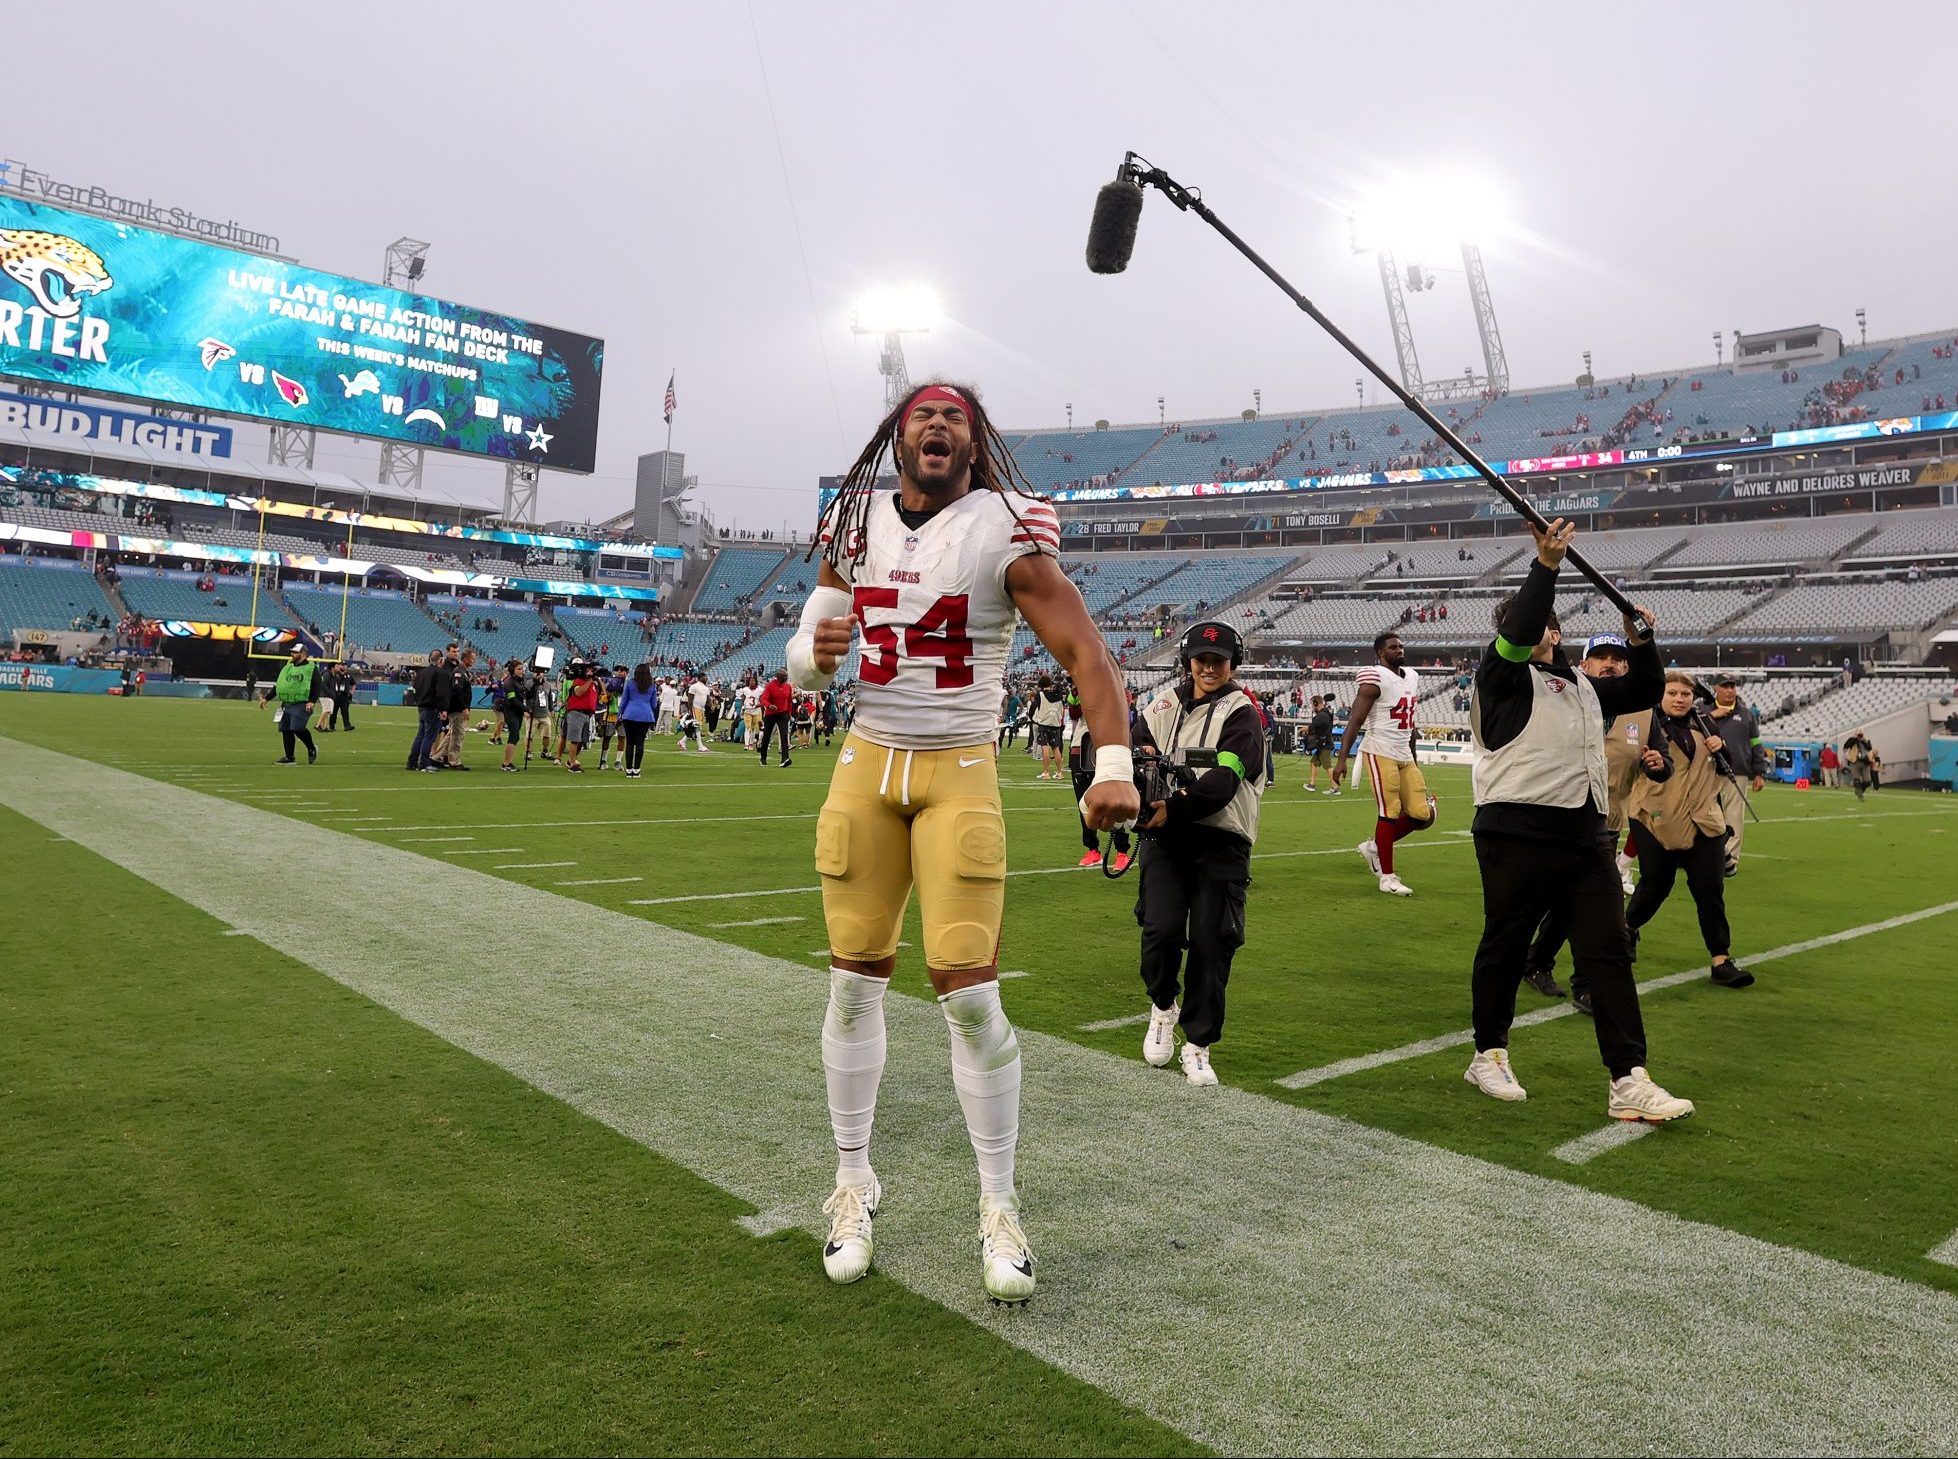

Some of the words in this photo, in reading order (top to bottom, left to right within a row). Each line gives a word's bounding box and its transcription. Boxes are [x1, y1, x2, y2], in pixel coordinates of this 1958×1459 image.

[20, 168, 161, 221] EverBank
[167, 207, 280, 252] Stadium
[228, 269, 275, 295] LIVE
[280, 281, 329, 307] LATE
[333, 294, 387, 320] GAME
[390, 307, 455, 335] ACTION
[460, 323, 508, 347] FROM
[511, 334, 543, 355] THE
[268, 298, 335, 327] FARAH
[340, 314, 354, 331] &
[360, 318, 420, 345] FARAH
[425, 332, 459, 353] FAN
[464, 341, 509, 364] DECK
[317, 337, 351, 356] THIS
[354, 344, 404, 366] WEEK'S
[407, 356, 477, 381] MATCHUPS
[239, 361, 265, 385] VS
[381, 394, 404, 415] VS
[5, 403, 92, 437] BUD
[99, 415, 220, 456] LIGHT
[502, 414, 522, 434] VS
[1628, 450, 1647, 460] 4TH
[1657, 446, 1682, 457] 0:00
[1316, 473, 1372, 488] JAGUARS
[1733, 481, 1771, 497] WAYNE
[1775, 479, 1799, 494] AND
[1802, 474, 1855, 492] DELORES
[1859, 468, 1911, 487] WEAVER
[1072, 489, 1119, 500] JAGUARS
[1535, 500, 1551, 511] THE
[1554, 496, 1600, 511] JAGUARS
[1079, 523, 1089, 533] 28
[1094, 523, 1111, 534] FRED
[1114, 522, 1139, 533] TAYLOR
[1286, 516, 1306, 527] TONY
[1308, 514, 1339, 525] BOSELLI
[888, 570, 920, 584] 49ERS
[32, 633, 44, 641] 147
[853, 587, 974, 688] 54
[1593, 635, 1622, 647] BEACH
[0, 666, 48, 675] ACKSVILLE
[749, 697, 756, 706] 3
